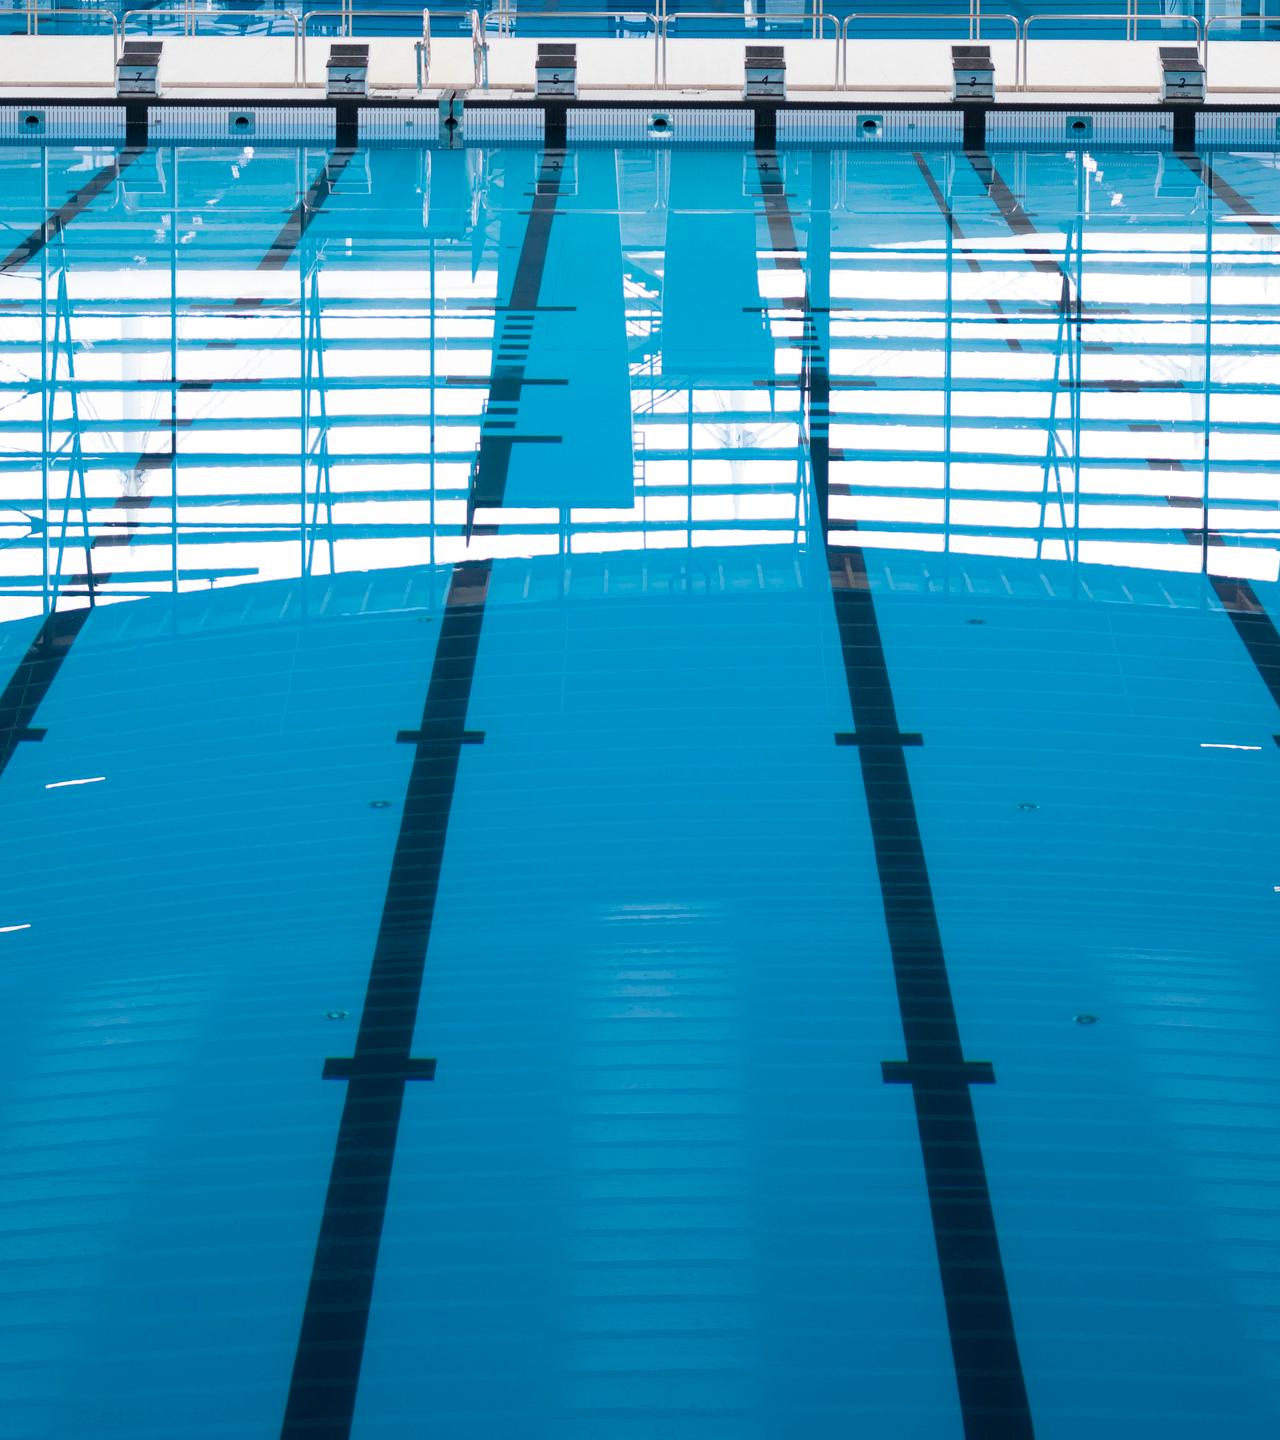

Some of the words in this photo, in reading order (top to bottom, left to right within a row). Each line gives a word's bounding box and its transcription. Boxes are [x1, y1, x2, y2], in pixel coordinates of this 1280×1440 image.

[135, 71, 143, 82] 7
[344, 73, 352, 84] 6
[553, 73, 560, 84] 5
[761, 74, 769, 85] 4
[969, 76, 977, 87] 3
[1177, 77, 1186, 88] 2
